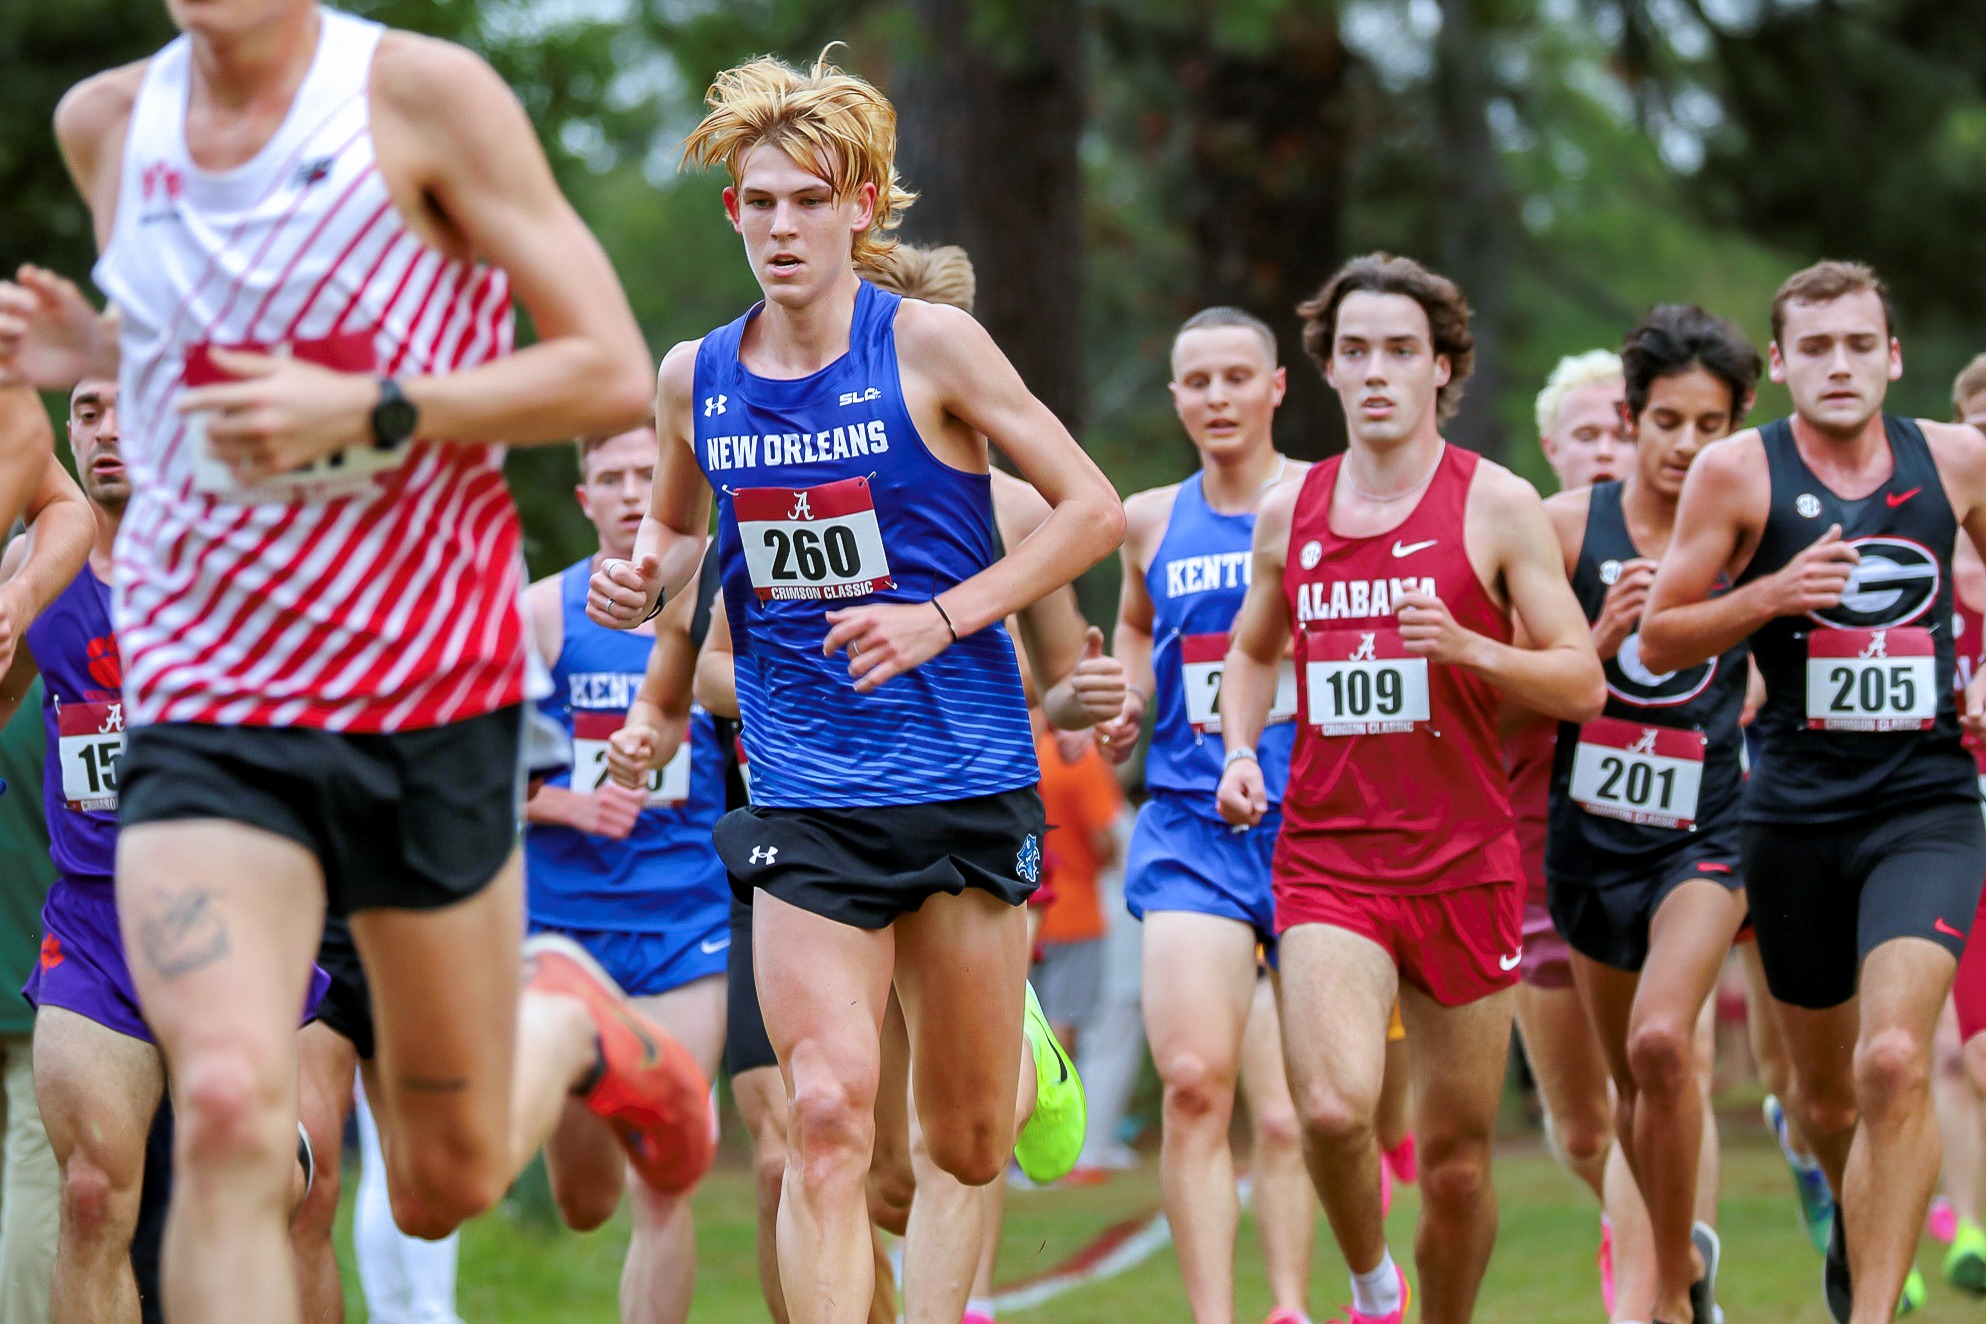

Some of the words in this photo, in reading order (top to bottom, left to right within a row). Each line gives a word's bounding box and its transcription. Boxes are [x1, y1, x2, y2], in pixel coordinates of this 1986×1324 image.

[707, 434, 758, 471] NEW
[763, 419, 889, 467] ORLEANS
[787, 491, 815, 521] A
[763, 525, 862, 581] 260
[770, 585, 822, 601] CRIMSON
[823, 580, 874, 600] CLASSIC
[1348, 632, 1376, 662] A
[1858, 630, 1888, 659] A
[1326, 669, 1403, 717] 109
[1830, 667, 1915, 712] 205
[98, 703, 125, 733] A
[1626, 728, 1658, 755] A
[1597, 757, 1675, 809] 201
